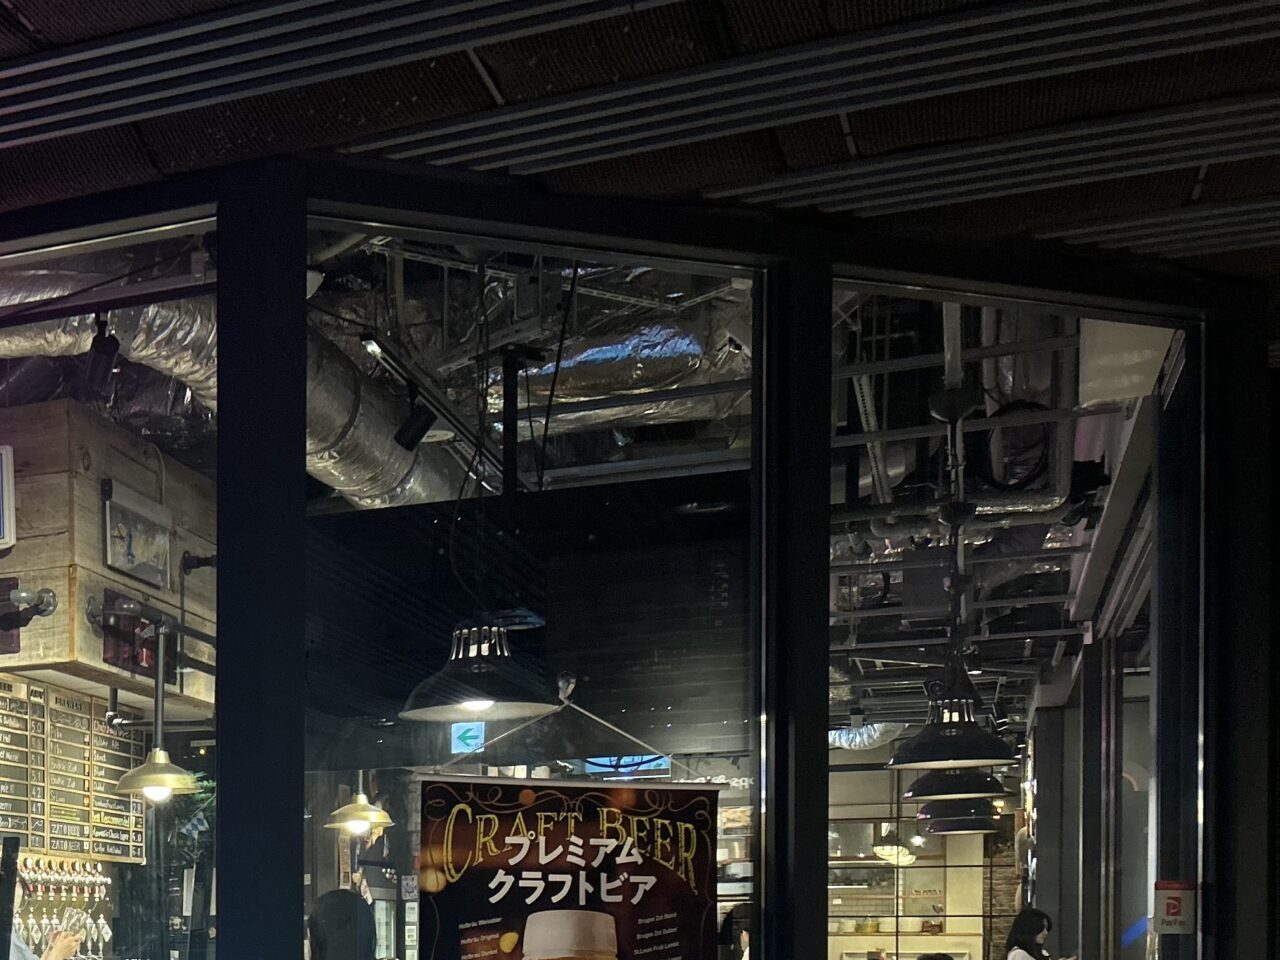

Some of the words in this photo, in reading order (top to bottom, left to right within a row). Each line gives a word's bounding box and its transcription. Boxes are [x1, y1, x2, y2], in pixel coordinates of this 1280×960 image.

[443, 802, 584, 883] CRAFT
[597, 807, 698, 896] BEER
[505, 830, 644, 867] プレミアム
[487, 870, 658, 906] クラフトビア
